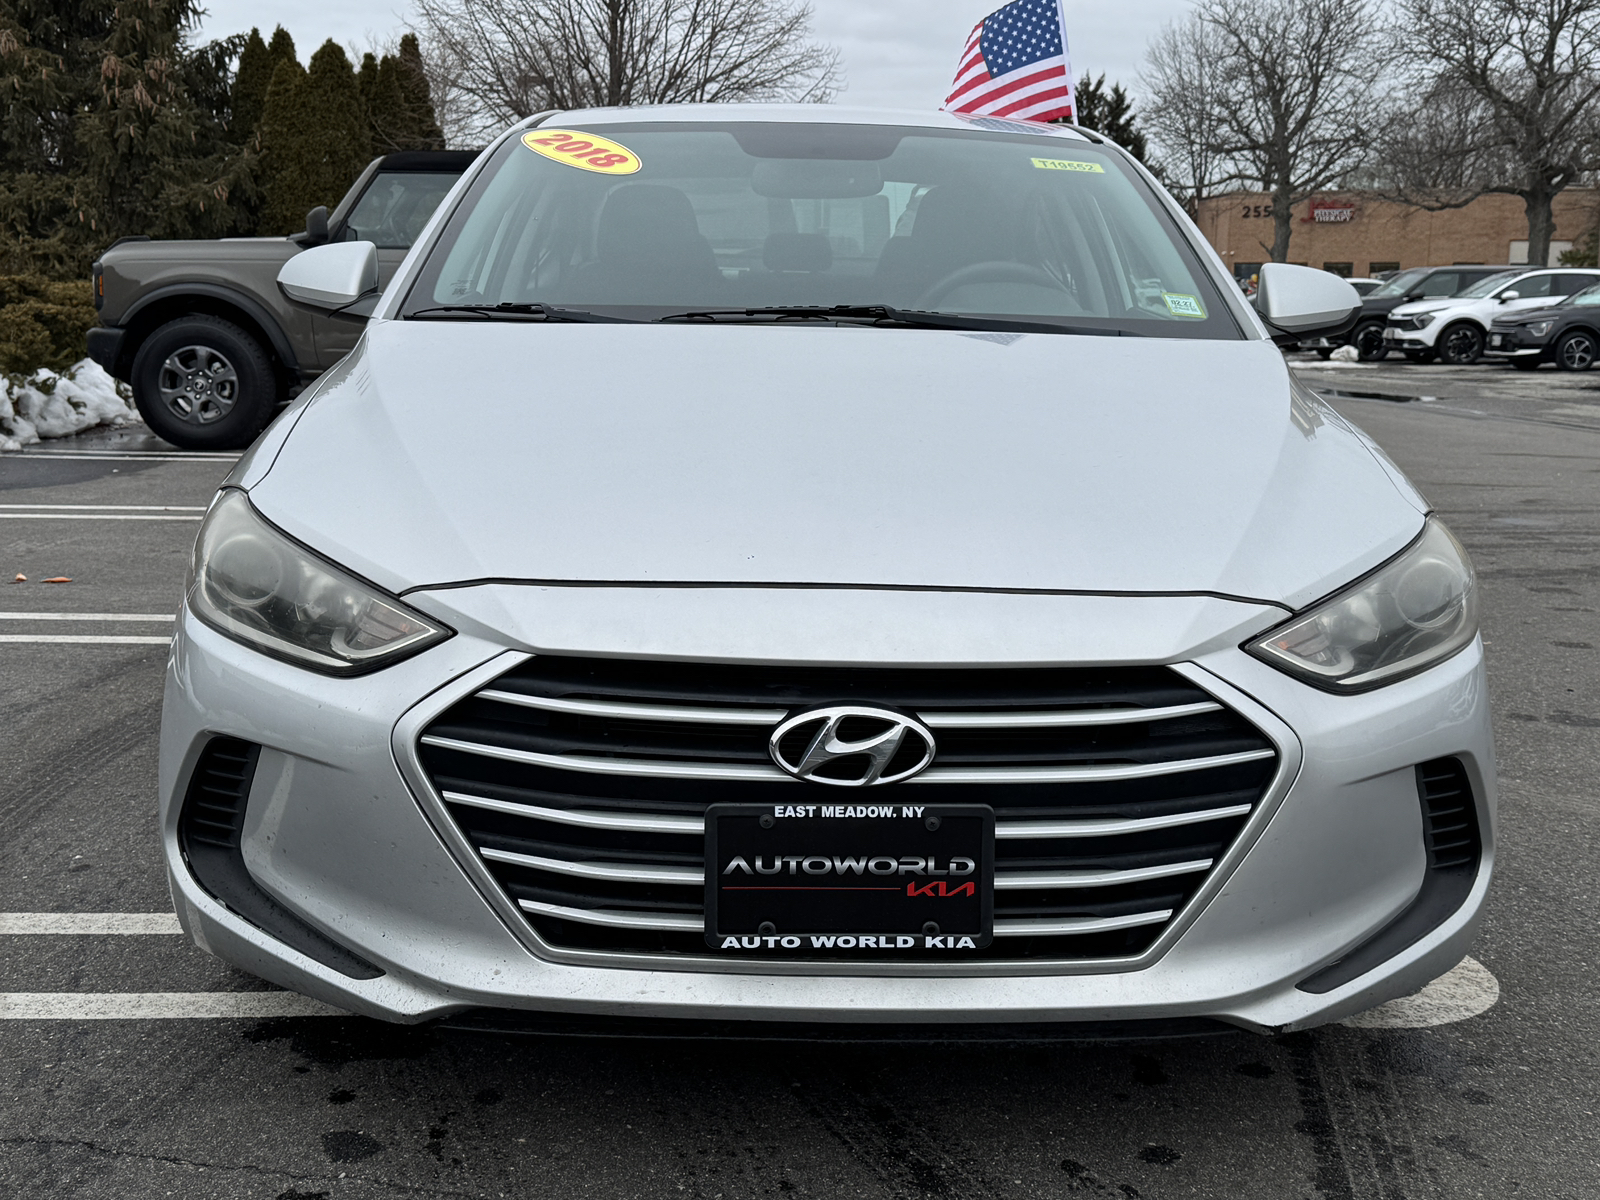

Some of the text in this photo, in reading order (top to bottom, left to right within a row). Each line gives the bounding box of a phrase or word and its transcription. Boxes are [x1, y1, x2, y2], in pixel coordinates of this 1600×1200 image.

[529, 133, 629, 168] 2018
[1242, 205, 1272, 218] 255
[1313, 208, 1352, 217] PHYSICAL
[1314, 214, 1351, 223] THERAPY
[774, 805, 816, 818] EAST
[902, 806, 926, 818] NY
[721, 855, 976, 876] AUTOWORLD
[720, 936, 977, 949] AUTO WORLD KIA
